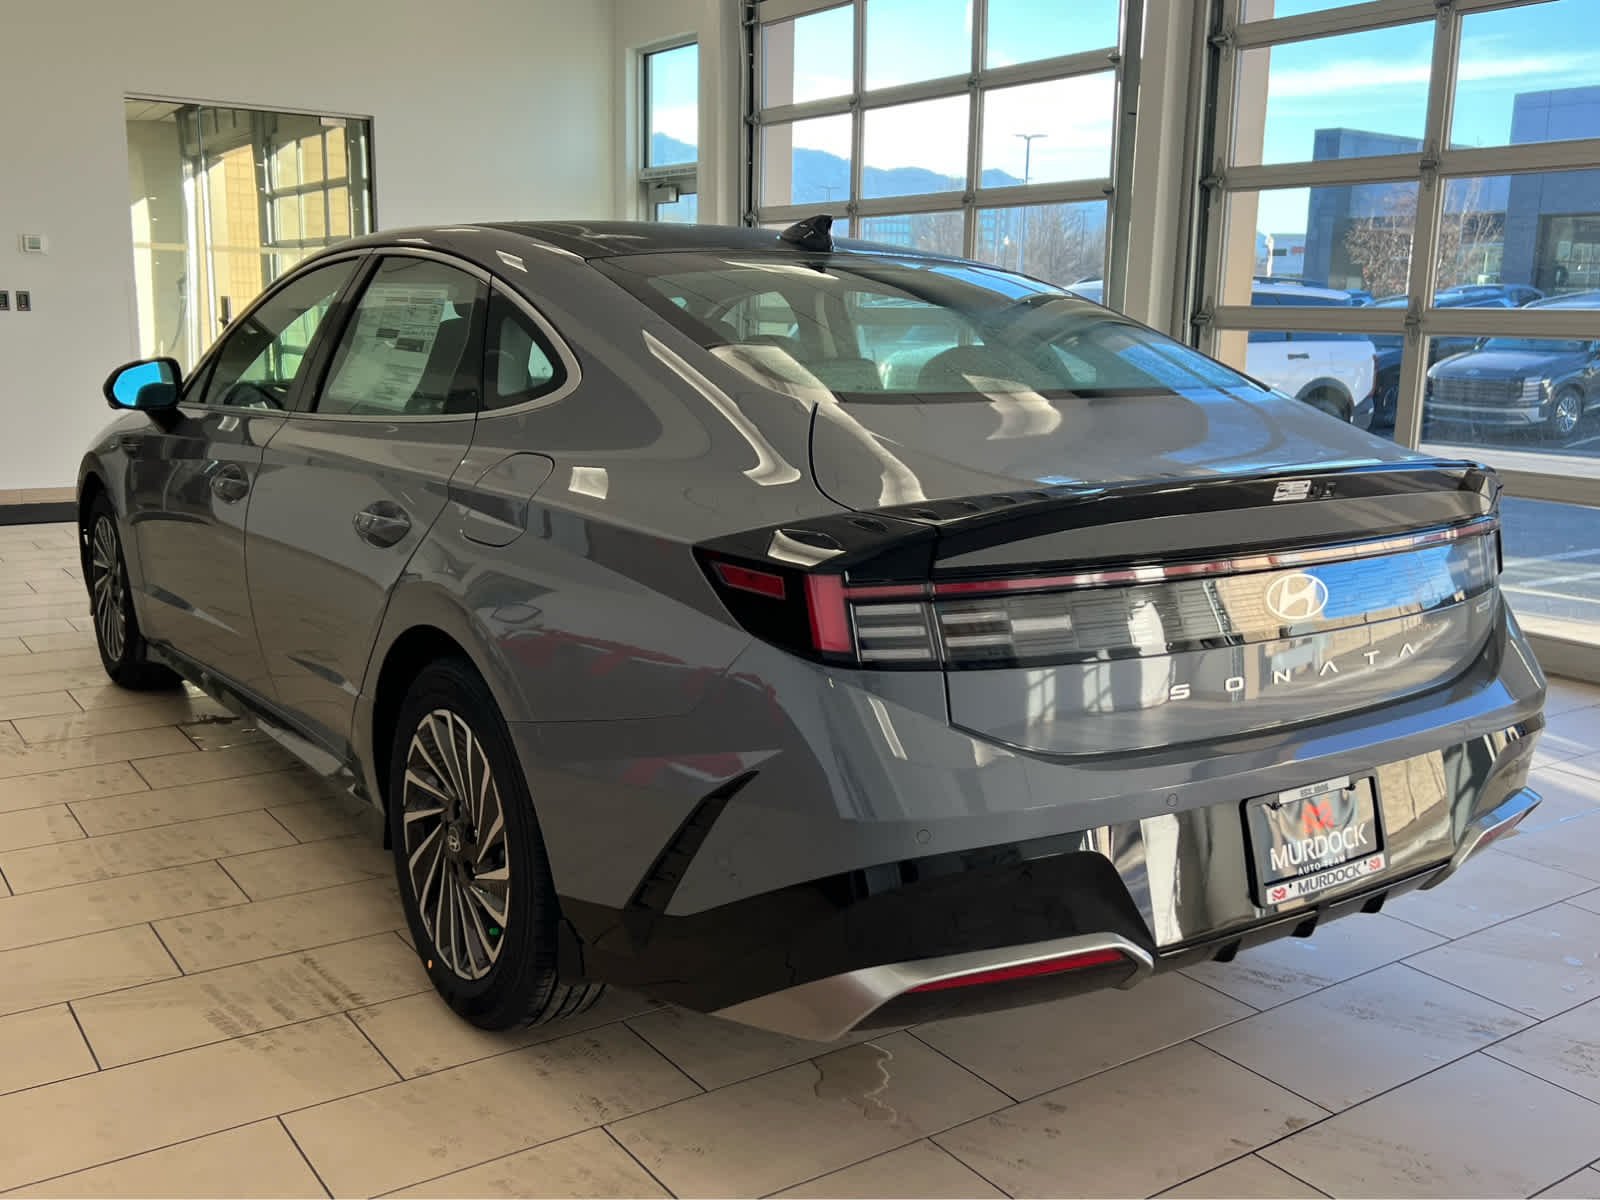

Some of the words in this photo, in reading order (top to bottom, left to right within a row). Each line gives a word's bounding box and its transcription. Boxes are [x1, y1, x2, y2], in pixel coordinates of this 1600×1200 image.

[1169, 643, 1416, 700] SONATA
[1270, 823, 1368, 871] MURDOCK
[1297, 862, 1321, 876] AUTO
[1297, 863, 1363, 895] MURDOCK
